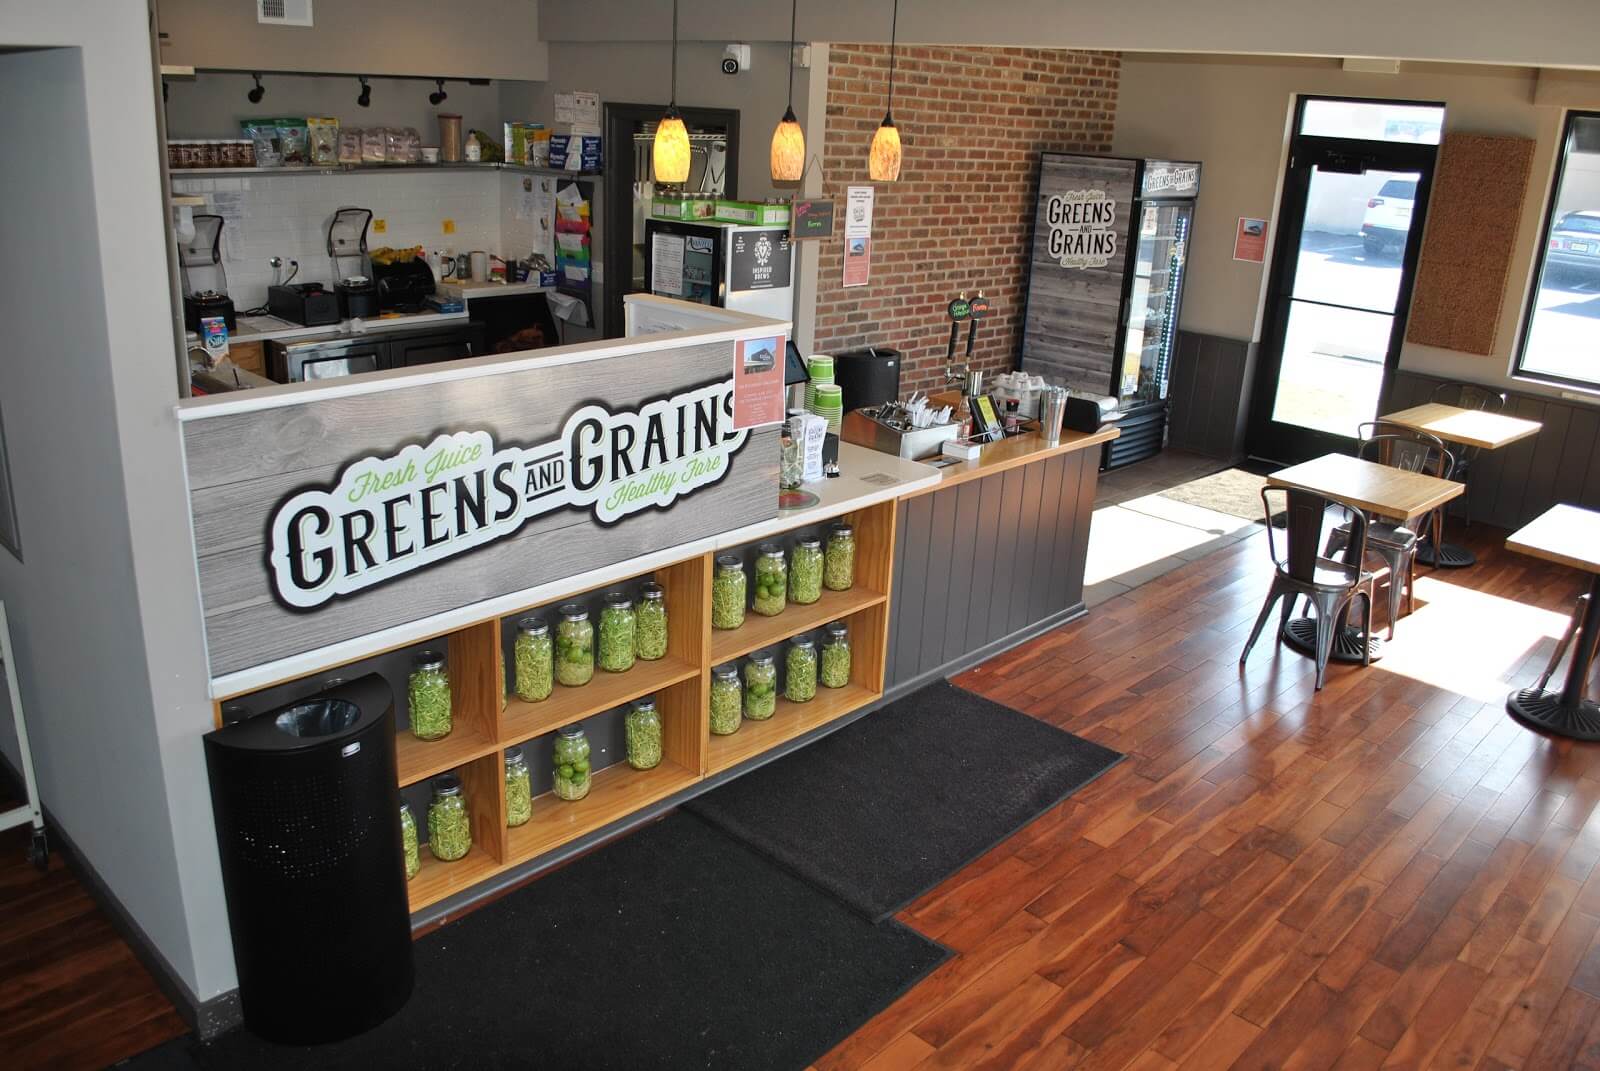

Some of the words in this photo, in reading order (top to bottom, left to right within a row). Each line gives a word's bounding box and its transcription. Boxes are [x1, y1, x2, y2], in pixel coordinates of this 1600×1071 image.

[1147, 174, 1170, 191] GREENS
[1174, 168, 1196, 185] GRAINS
[1048, 198, 1113, 224] GREENS
[1050, 228, 1114, 255] GRAINS
[1080, 225, 1093, 233] AND
[348, 459, 418, 502] Fresh
[424, 443, 482, 484] Juice
[605, 470, 677, 510] Healthy
[681, 456, 721, 483] Fare
[286, 461, 521, 590] GREENS
[525, 457, 564, 493] AND
[569, 390, 740, 491] GRAINS
